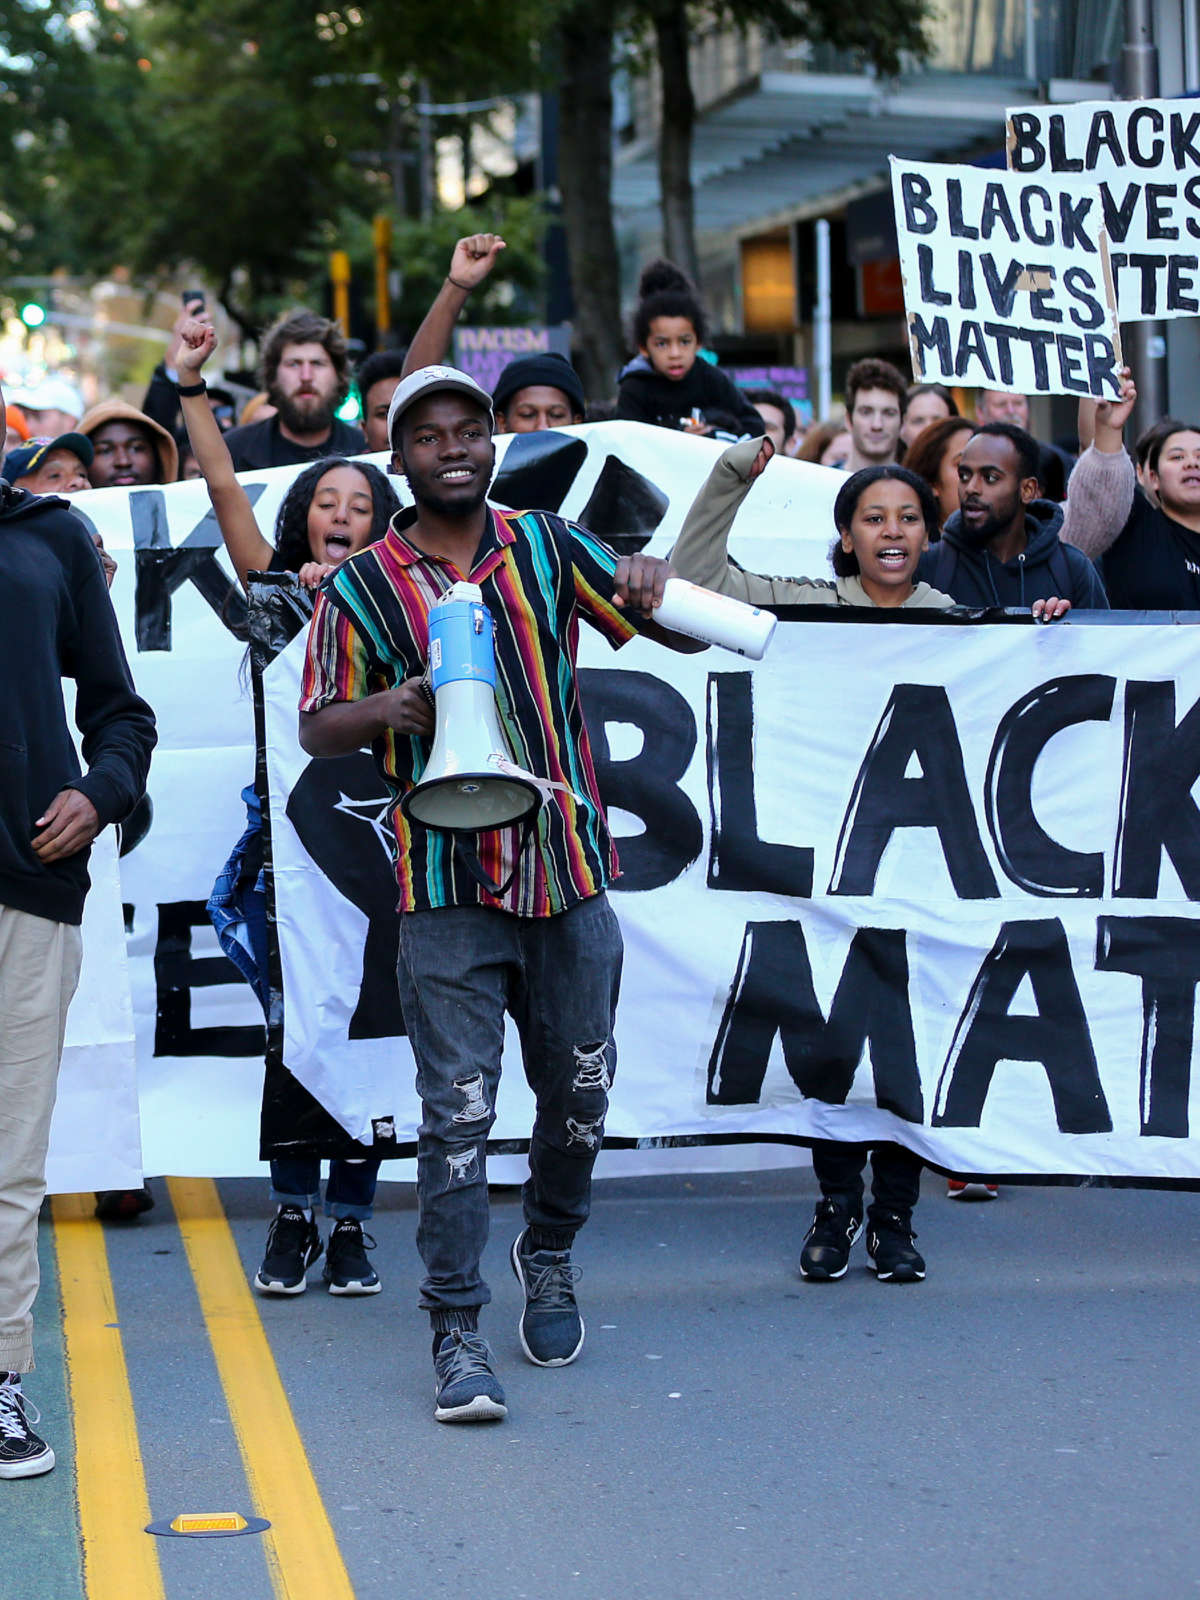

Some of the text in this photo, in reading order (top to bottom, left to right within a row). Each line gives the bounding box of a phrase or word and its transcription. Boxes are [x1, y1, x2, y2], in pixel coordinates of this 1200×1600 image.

[1010, 107, 1200, 173] BLACK
[901, 172, 1097, 253] BLACK
[917, 243, 1104, 329] LIVES
[910, 311, 1124, 399] MATTER
[577, 668, 1200, 902] BLACK
